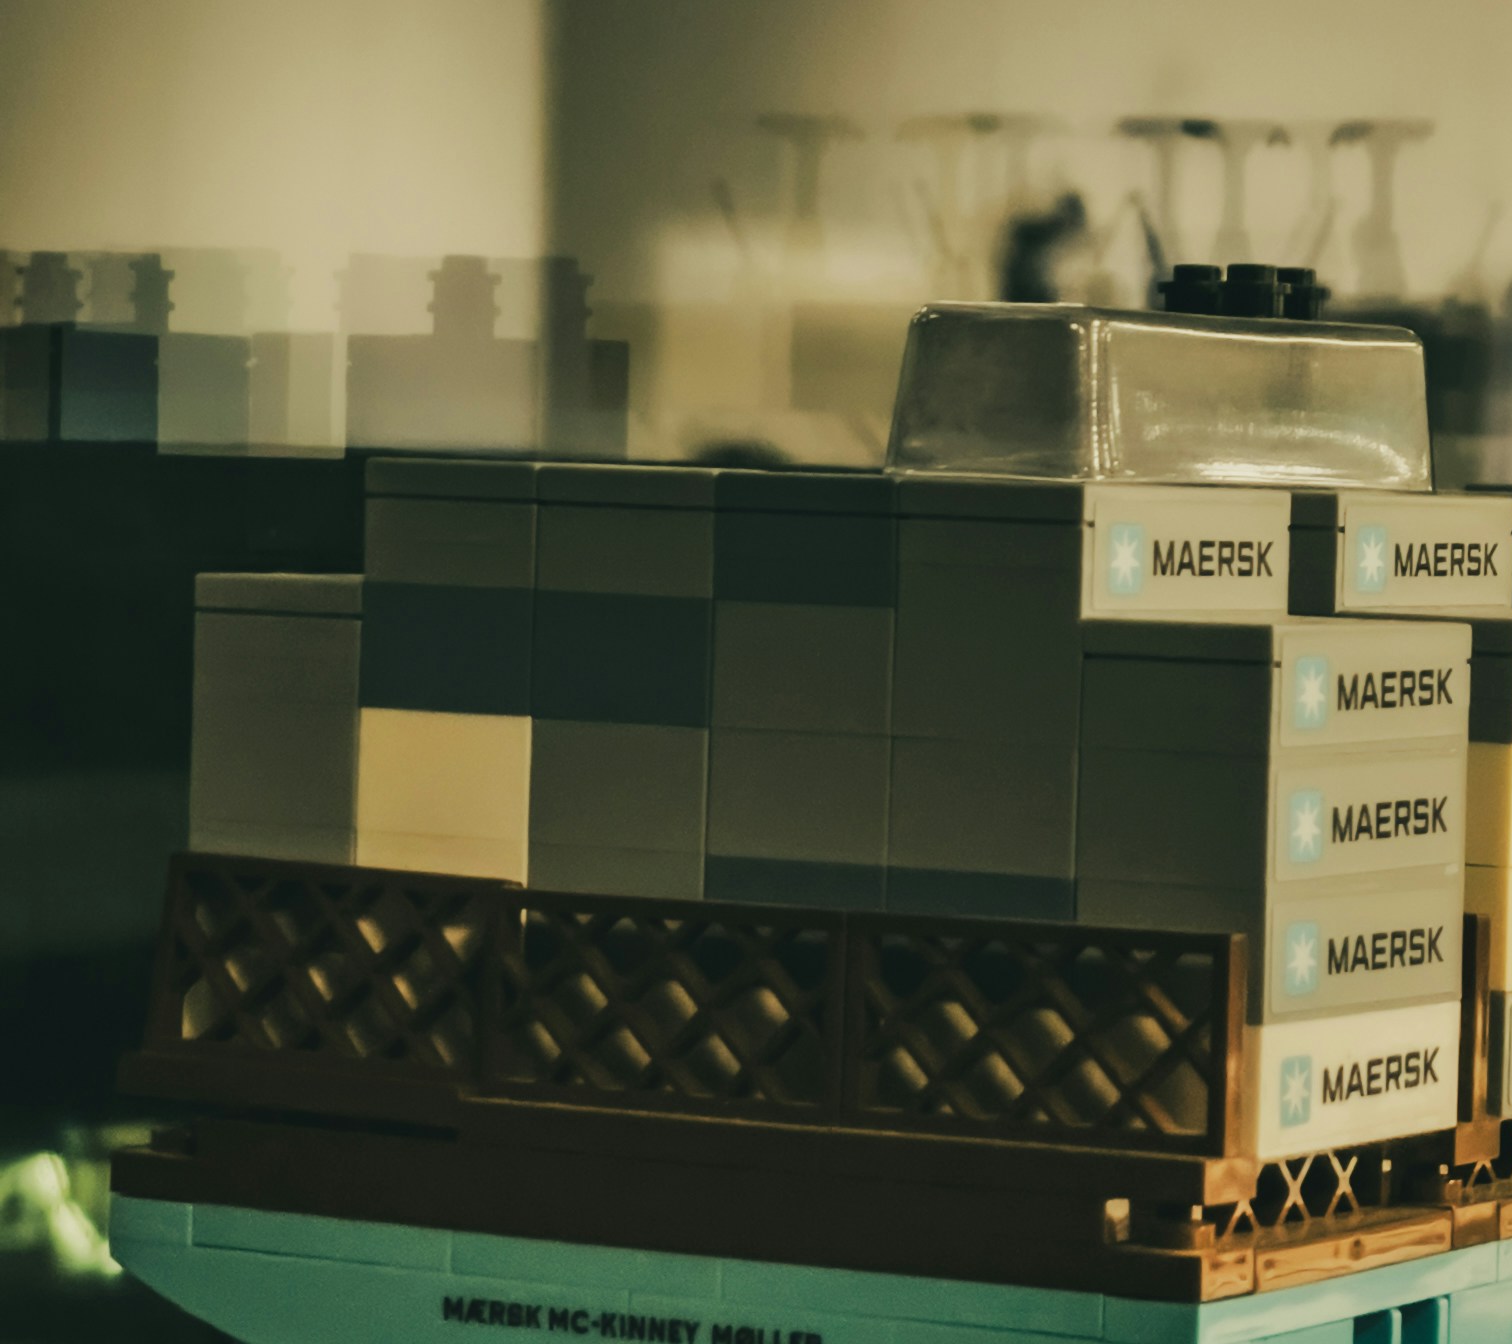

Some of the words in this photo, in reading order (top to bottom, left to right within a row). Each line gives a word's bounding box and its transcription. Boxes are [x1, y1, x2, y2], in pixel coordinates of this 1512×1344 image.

[1152, 539, 1273, 577] MAERSK
[1394, 542, 1498, 578] MAERSK
[1337, 668, 1453, 711] MAERSK
[1331, 796, 1448, 844] MAERSK
[1327, 926, 1444, 976] MAERSK
[1322, 1047, 1440, 1104] MAERSK
